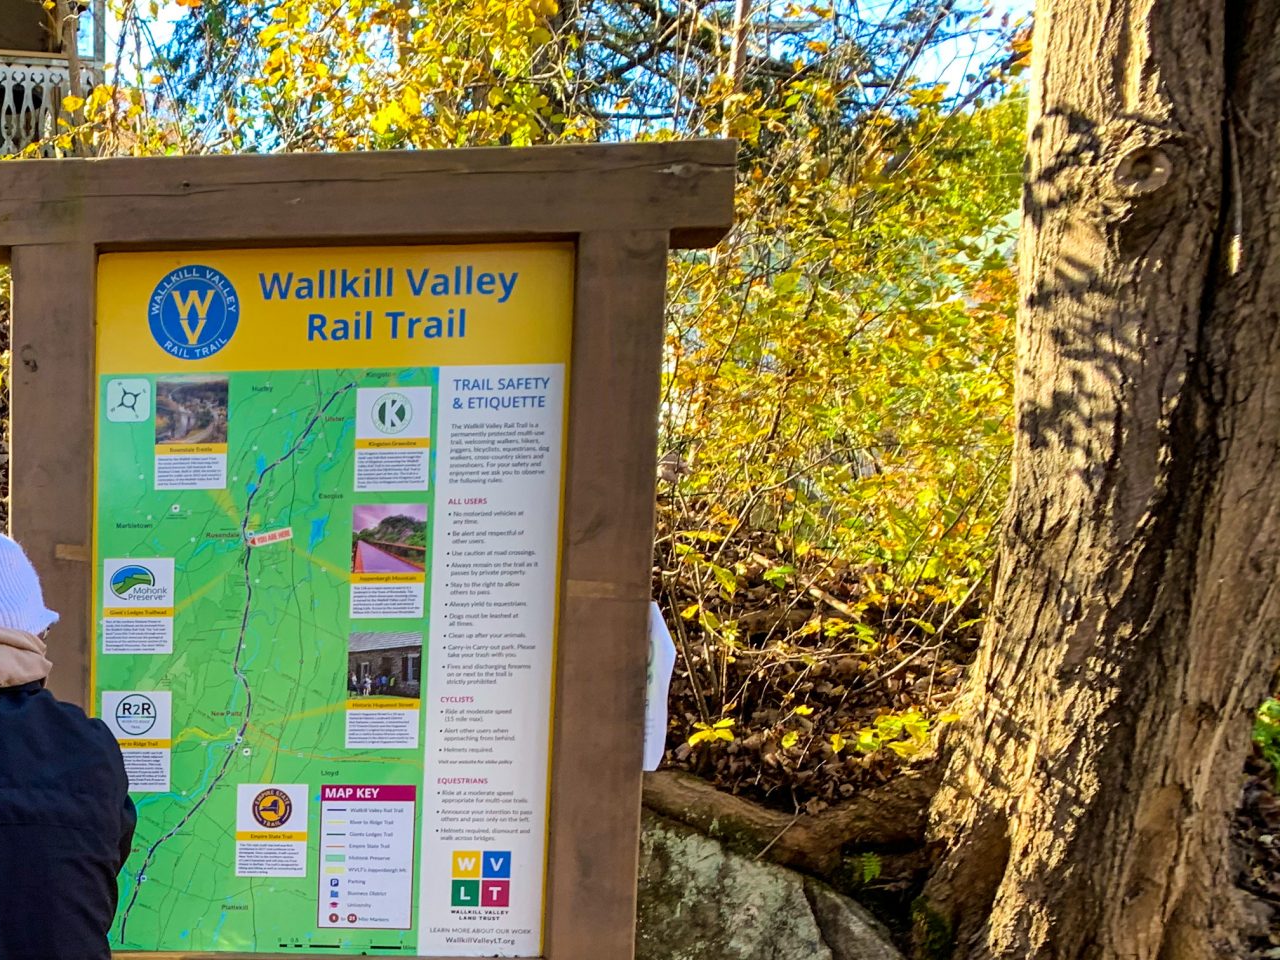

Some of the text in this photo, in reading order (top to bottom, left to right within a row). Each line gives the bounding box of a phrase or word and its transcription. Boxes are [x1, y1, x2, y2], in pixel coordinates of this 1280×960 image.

[258, 265, 519, 303] Wallkill Valley
[151, 268, 237, 316] WALLKILL VALLEY
[308, 308, 466, 342] Rail Trail
[163, 337, 227, 358] RAIL TRAIL
[453, 377, 550, 391] TRAIL SAFETY
[452, 395, 546, 411] & ETIQUETTE
[257, 529, 291, 544] YOU ARE HERE
[122, 703, 151, 715] R2R
[255, 789, 290, 805] EMPIRE STATE
[325, 788, 379, 798] MAP KEY
[457, 858, 504, 872] W V
[460, 886, 502, 901] L T
[445, 937, 515, 945] WallkillValleyLT.org
